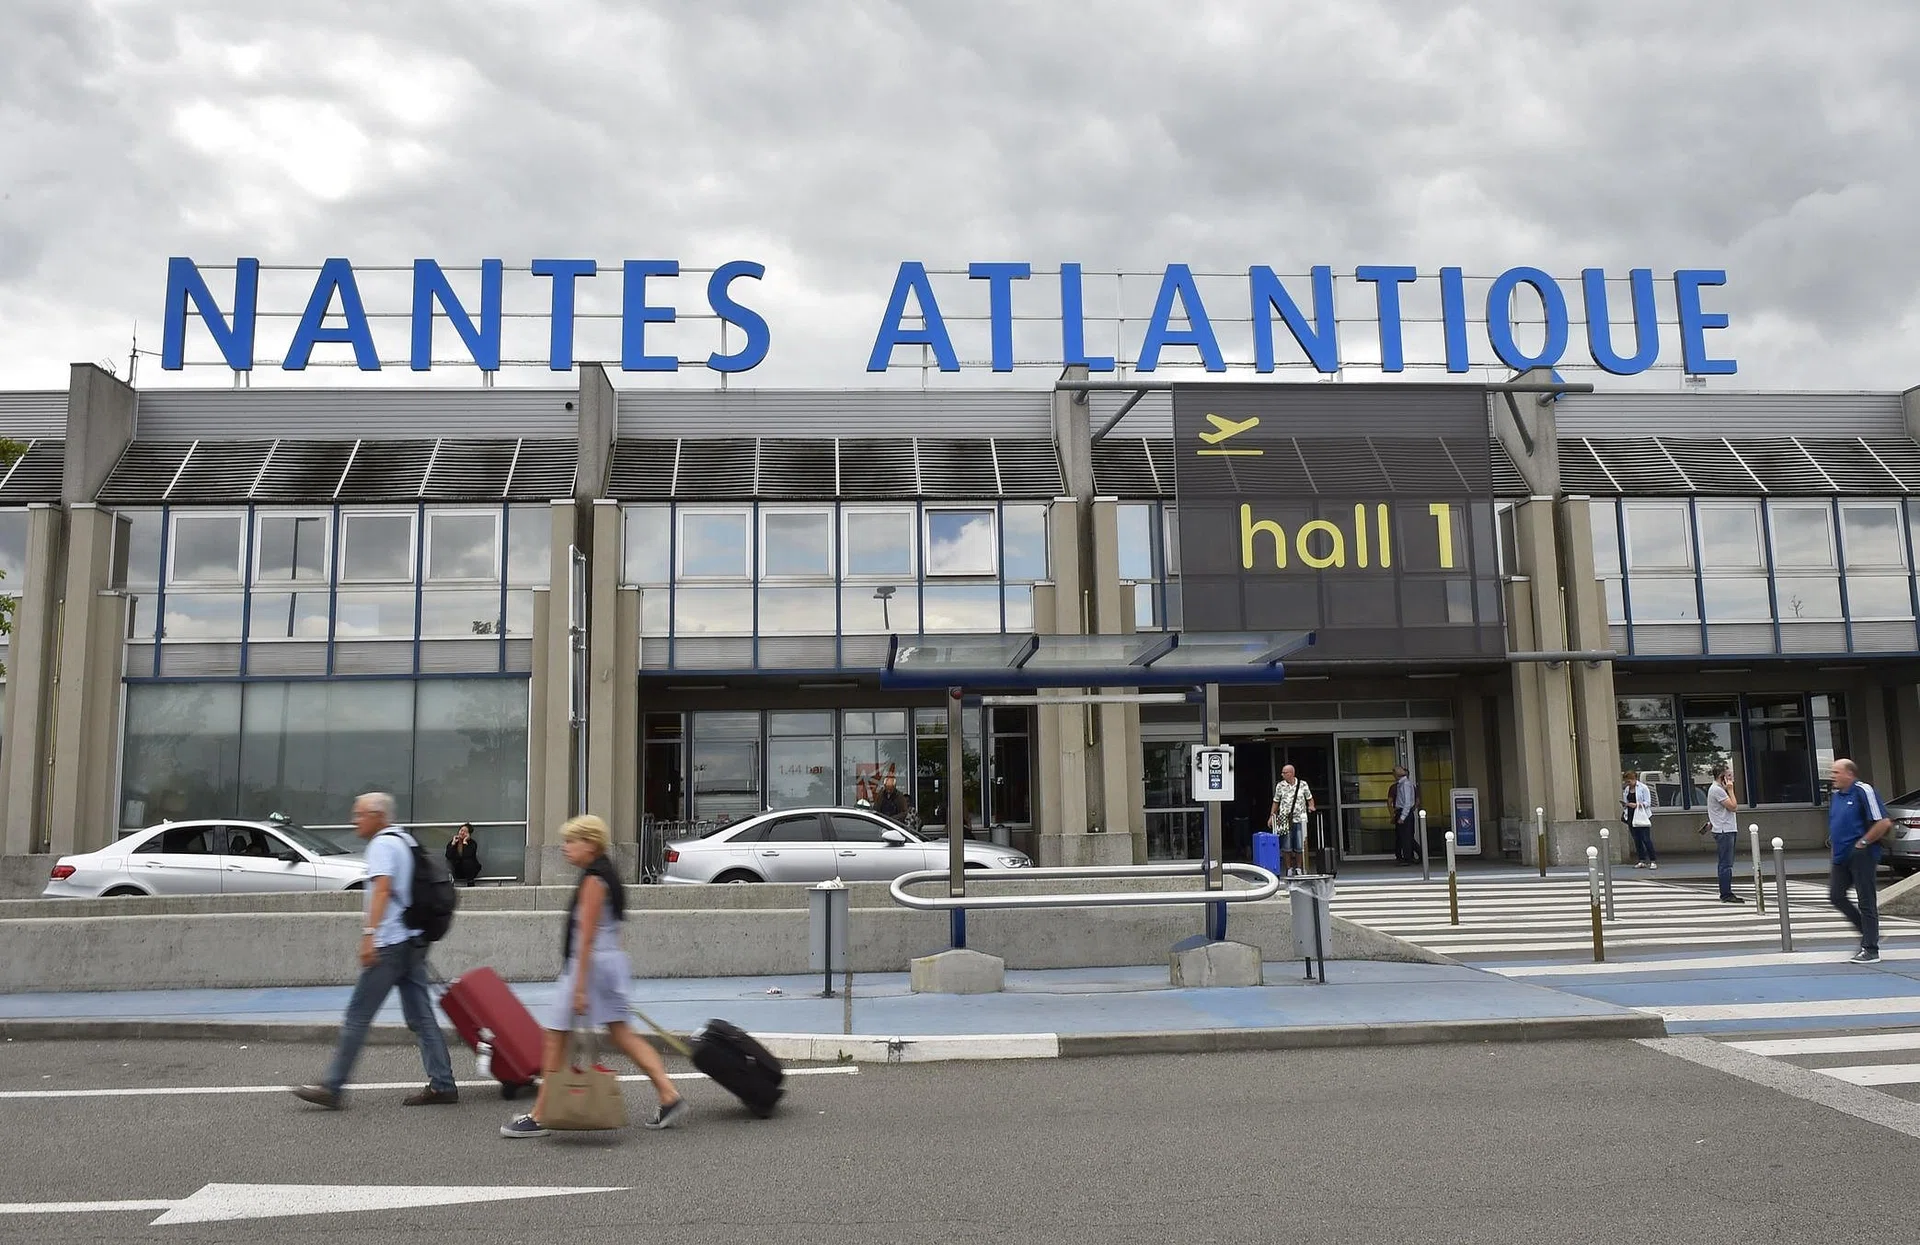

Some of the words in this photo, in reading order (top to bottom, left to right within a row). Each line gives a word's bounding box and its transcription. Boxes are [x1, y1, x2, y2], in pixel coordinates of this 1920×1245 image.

[161, 257, 770, 373] NANTES
[866, 261, 1738, 398] ATLANTIQUE
[1240, 503, 1390, 569] hall
[1429, 503, 1453, 568] 1
[806, 764, 824, 775] bar
